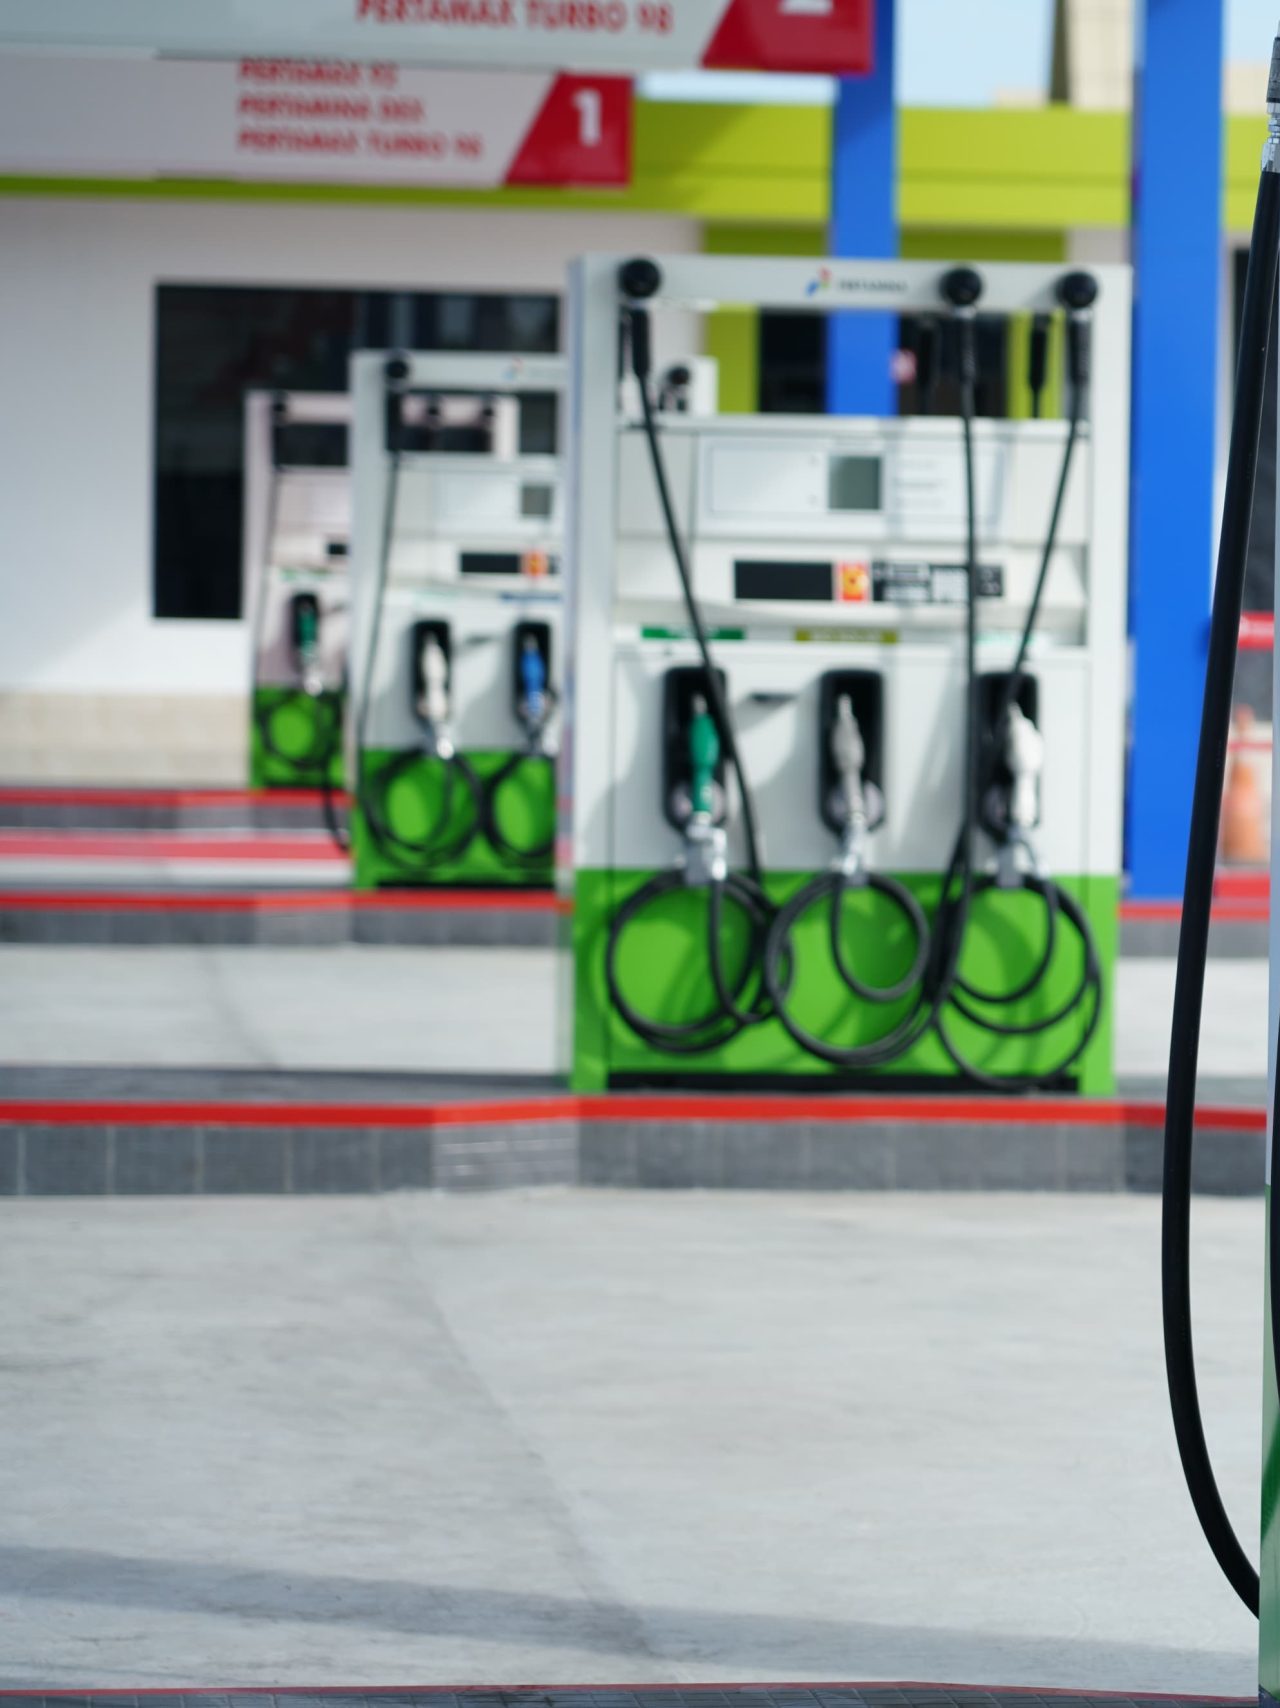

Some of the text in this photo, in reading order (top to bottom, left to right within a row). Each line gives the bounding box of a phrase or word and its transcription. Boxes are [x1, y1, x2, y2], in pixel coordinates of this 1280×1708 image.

[356, 0, 514, 28] PERTAMAX
[526, 1, 625, 33] TURBO
[571, 89, 602, 146] 1
